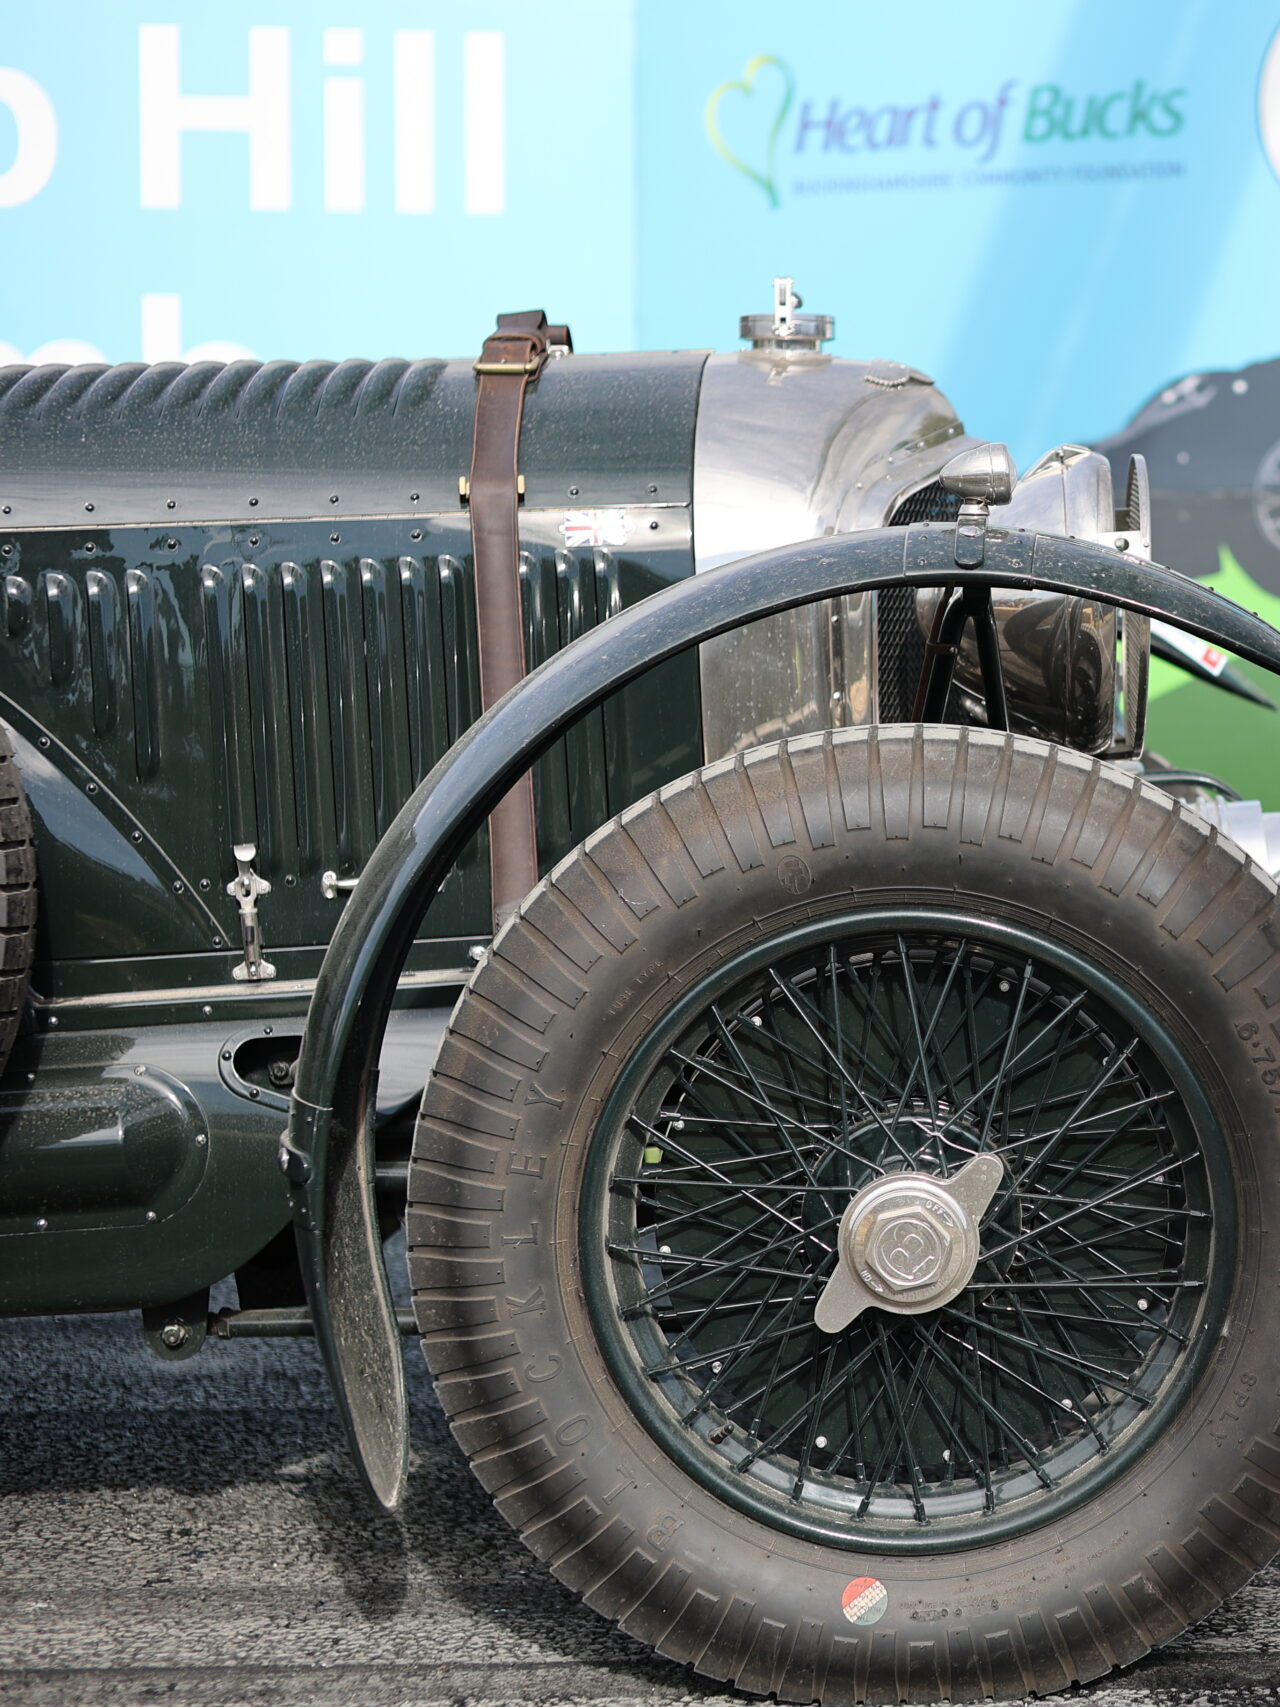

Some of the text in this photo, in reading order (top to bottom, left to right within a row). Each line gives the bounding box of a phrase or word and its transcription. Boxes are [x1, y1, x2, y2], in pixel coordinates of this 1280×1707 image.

[138, 22, 507, 216] Hill
[793, 77, 1191, 164] Heart of Bucks
[925, 1200, 946, 1215] OFF
[503, 1082, 686, 1553] BLOCKLEY
